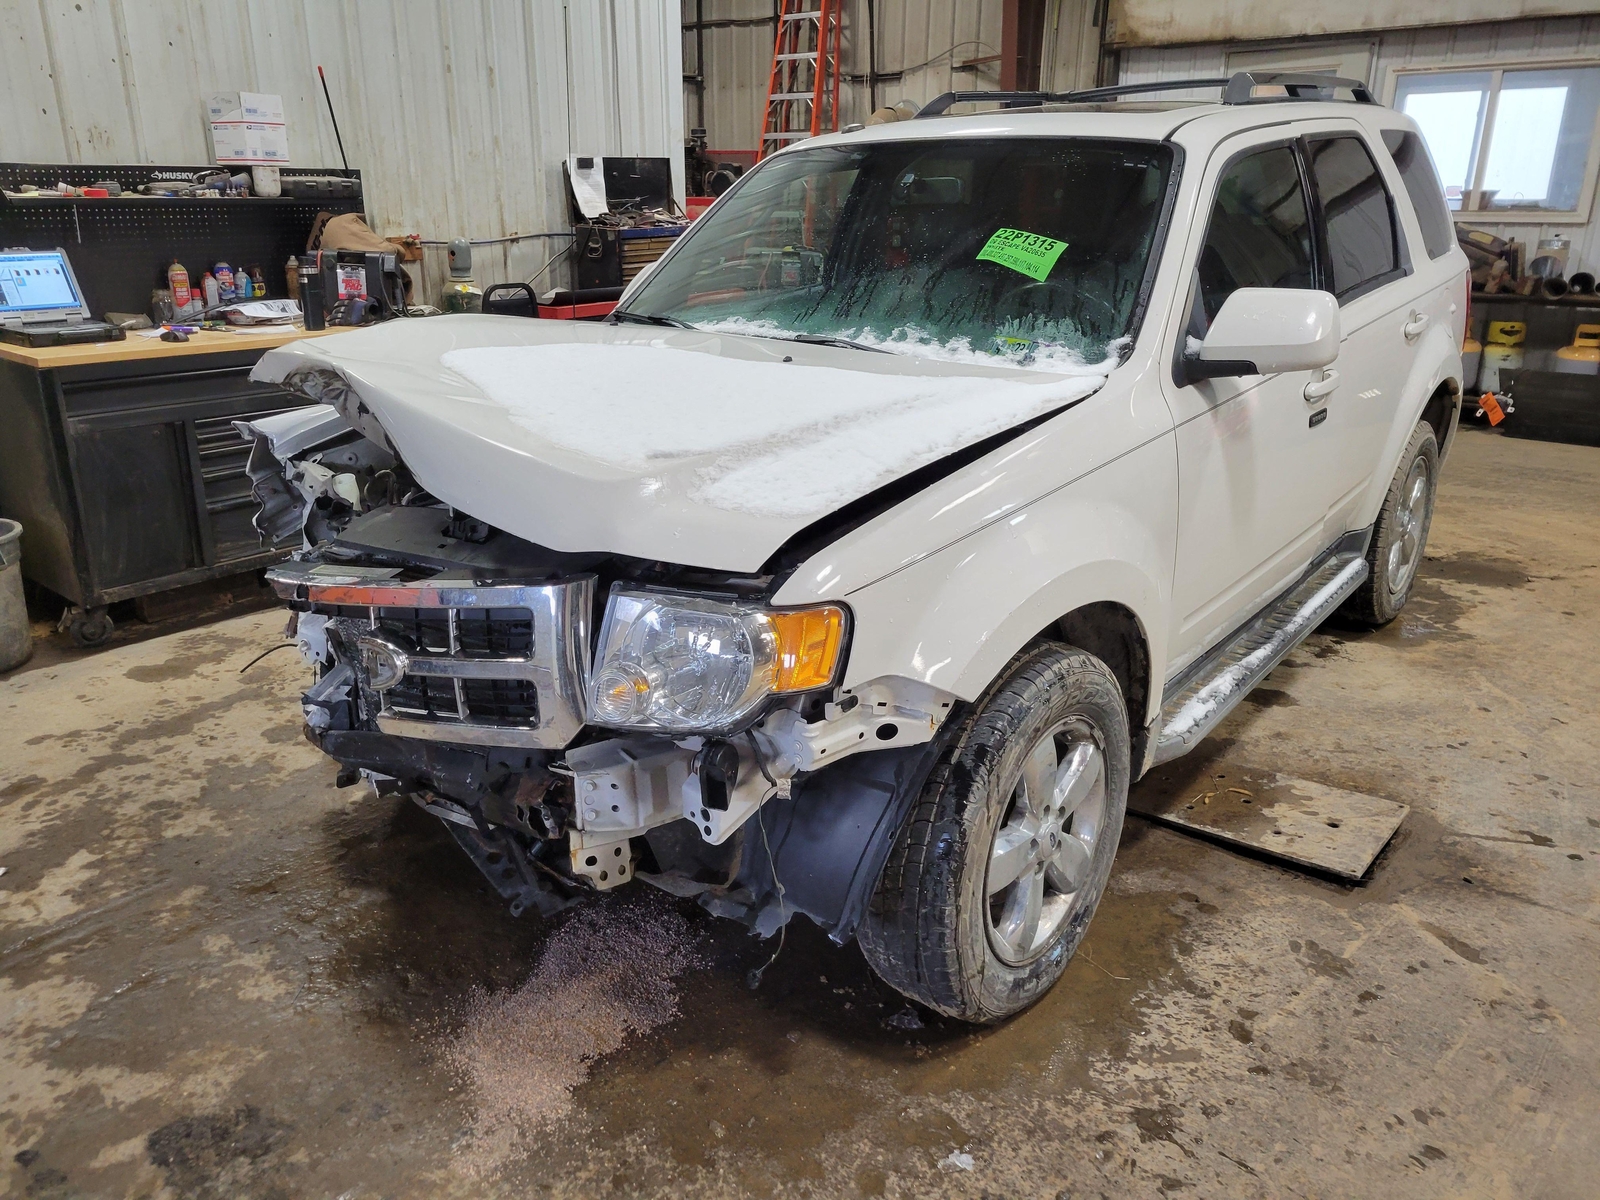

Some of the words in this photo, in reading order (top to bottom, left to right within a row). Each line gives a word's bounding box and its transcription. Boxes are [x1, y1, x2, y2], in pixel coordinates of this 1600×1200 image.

[162, 171, 194, 180] HUSKY
[995, 229, 1058, 251] 22P1315
[997, 239, 1022, 250] ESCAPE
